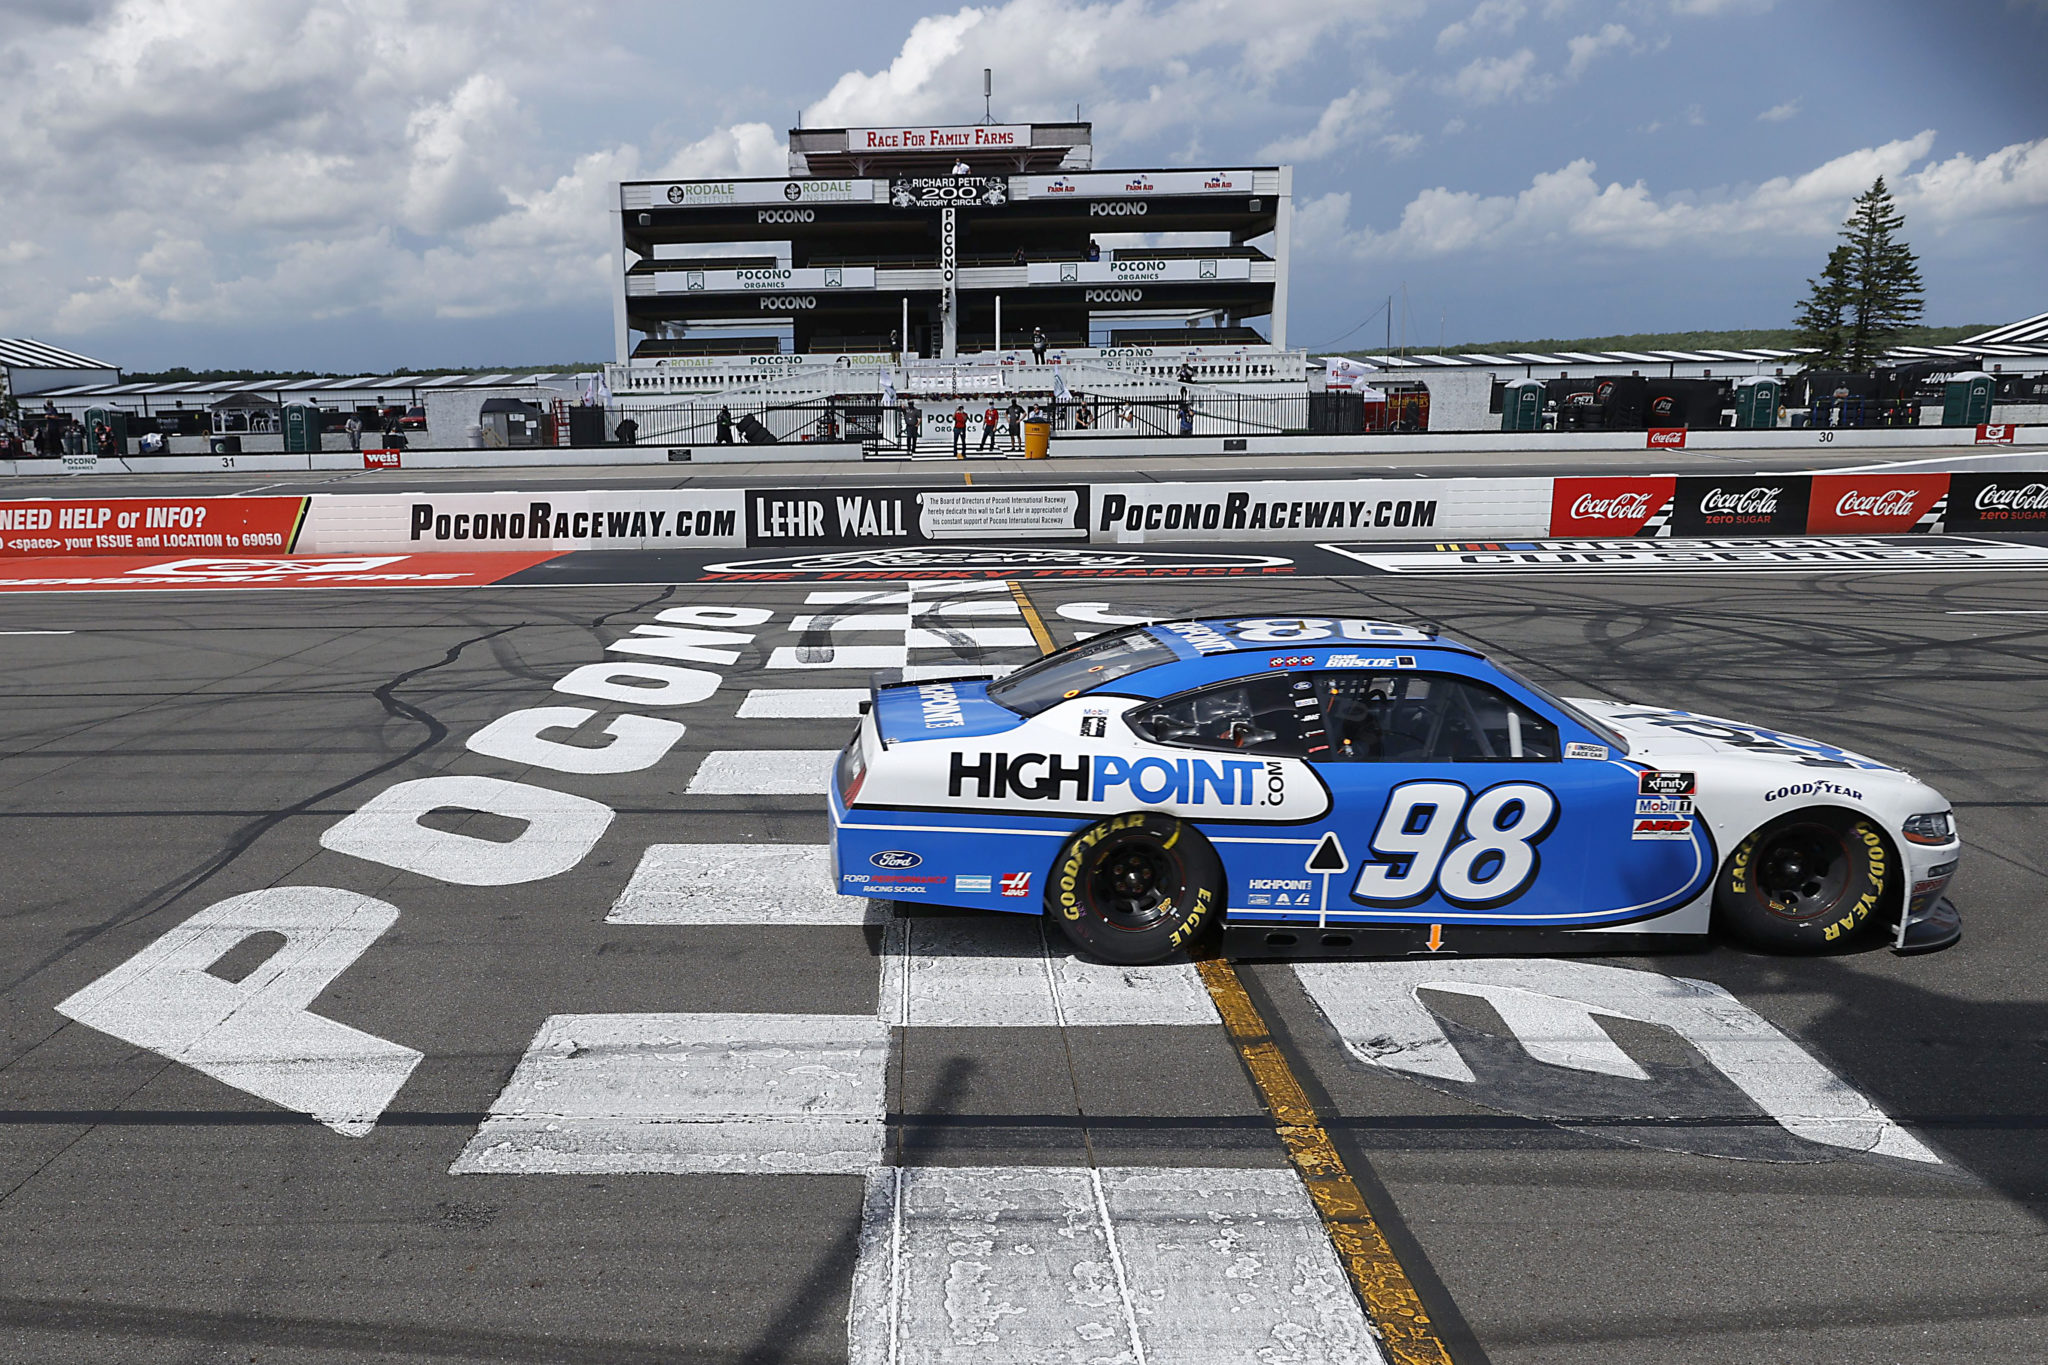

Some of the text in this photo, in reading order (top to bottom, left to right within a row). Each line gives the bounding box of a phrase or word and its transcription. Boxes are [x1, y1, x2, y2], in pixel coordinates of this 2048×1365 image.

[866, 129, 1014, 147] RACE FOR FAMILY FARMS
[802, 182, 852, 193] RODALE
[912, 177, 987, 187] RICHARD PETTY
[1204, 181, 1221, 189] FARM
[685, 184, 735, 195] RODALE
[921, 186, 977, 199] 200
[915, 198, 982, 207] VICTORY CIRCLE
[1090, 202, 1148, 216] POCONO
[757, 209, 815, 223] POCONO
[944, 209, 954, 282] POCONO
[1110, 261, 1166, 271] POCONO
[736, 270, 792, 280] POCONO
[1085, 289, 1143, 302] POCONO
[760, 296, 816, 310] POCONO
[1101, 349, 1153, 357] POCONO
[750, 356, 803, 365] POCONO
[927, 414, 984, 423] POCNO
[1651, 432, 1683, 443] Coca-Cola
[1819, 432, 1833, 442] 30
[222, 457, 235, 467] 31
[366, 451, 398, 462] weis
[930, 497, 939, 505] The
[940, 497, 955, 505] Board
[1044, 496, 1067, 504] Raceway
[1700, 487, 1783, 514] Coca-Cola
[1974, 483, 2048, 509] Coca-Cola
[1570, 493, 1653, 519] Coca-Cola
[1835, 490, 1920, 516] Coca-Cola
[756, 496, 908, 537] LEHR WALL
[928, 508, 944, 516] hereby
[1031, 507, 1062, 515] appreciation
[1980, 511, 2046, 520] zero SUGAR
[0, 507, 207, 530] NEED HELP or INFO?
[963, 518, 982, 526] support
[1041, 516, 1064, 524] Raceway
[1705, 515, 1771, 524] zero SUGAR
[8, 533, 282, 551] <space> your ISSUE and LOCATION to 69050
[1541, 538, 1894, 550] NASCAR
[1460, 549, 1989, 563] CUP SERIES
[697, 567, 1297, 581] THE TRICKY TRIANGLE
[1325, 658, 1396, 667] BRISCOE
[948, 751, 1264, 806] HIGHPOINT
[1648, 777, 1689, 790] xfinity
[1764, 781, 1863, 801] GOODYEAR
[1639, 800, 1690, 811] Mobil 1
[1635, 820, 1691, 831] ARP
[1353, 781, 1558, 905] 98
[879, 852, 912, 867] Ford
[1732, 831, 1761, 894] EAGLE
[54, 606, 775, 1138] POCONO
[843, 874, 870, 883] FORD
[871, 875, 948, 884] PERFORMANCE
[1249, 879, 1308, 890] HIGHPOINT
[1169, 888, 1212, 947] EAGLE
